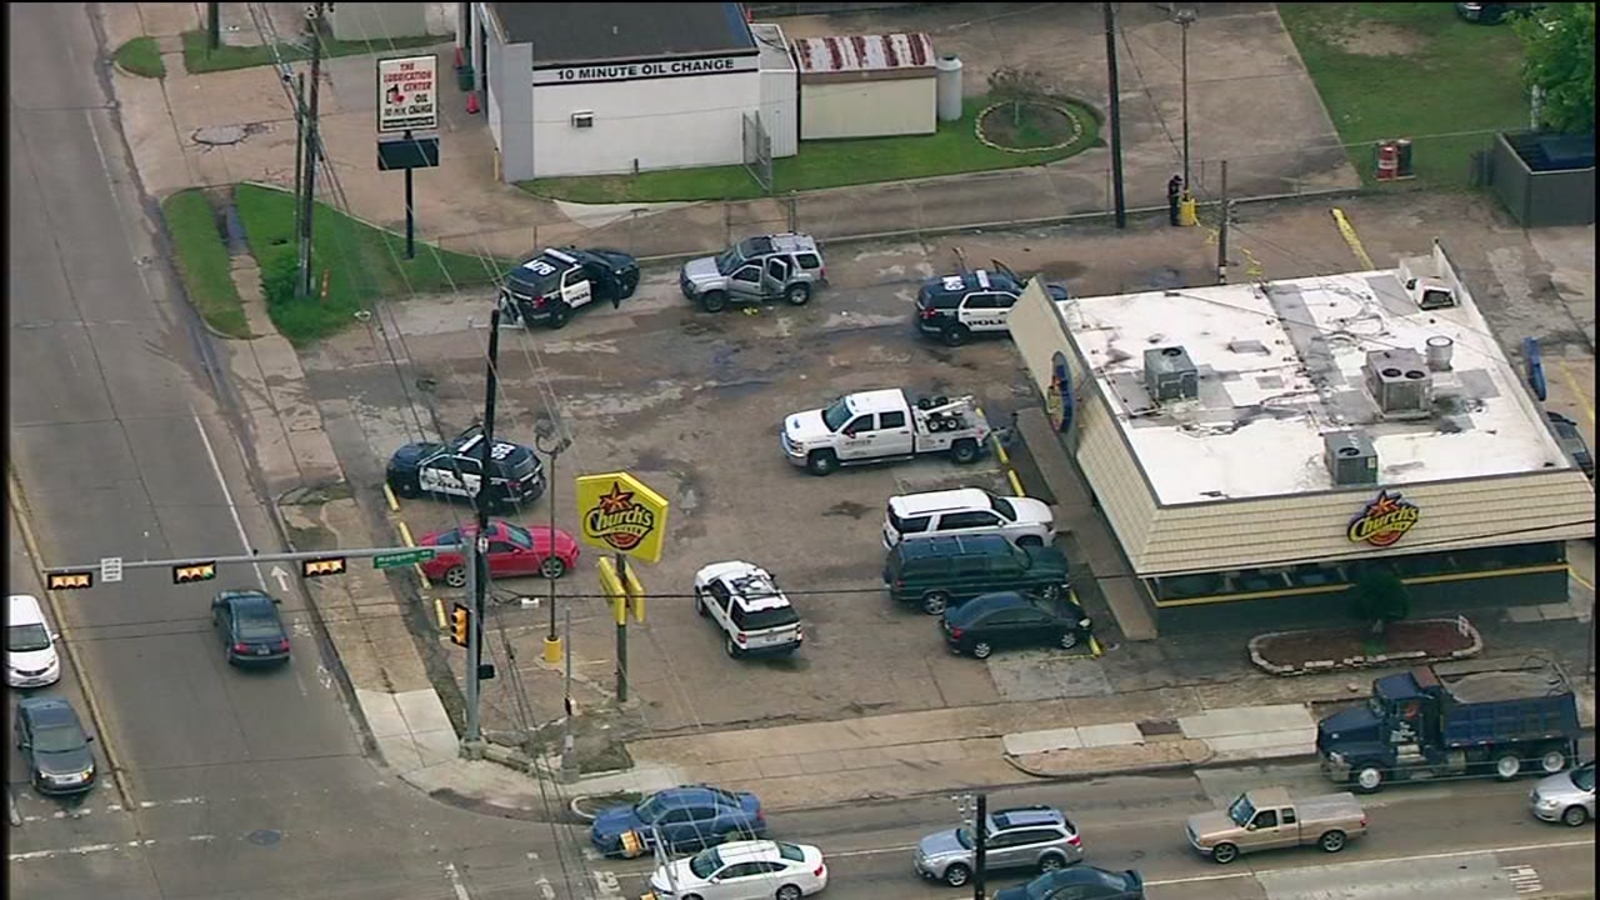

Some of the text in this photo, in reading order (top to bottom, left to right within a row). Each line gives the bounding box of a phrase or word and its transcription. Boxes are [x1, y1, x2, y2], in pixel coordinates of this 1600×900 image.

[400, 63, 415, 71] THE
[557, 59, 734, 80] 10 MINUTE OIL CHANGE
[384, 70, 433, 83] LUBRICATION
[403, 81, 433, 92] CENTER
[414, 94, 428, 103] OIL
[584, 504, 653, 538] Church's
[1349, 505, 1417, 541] Church's
